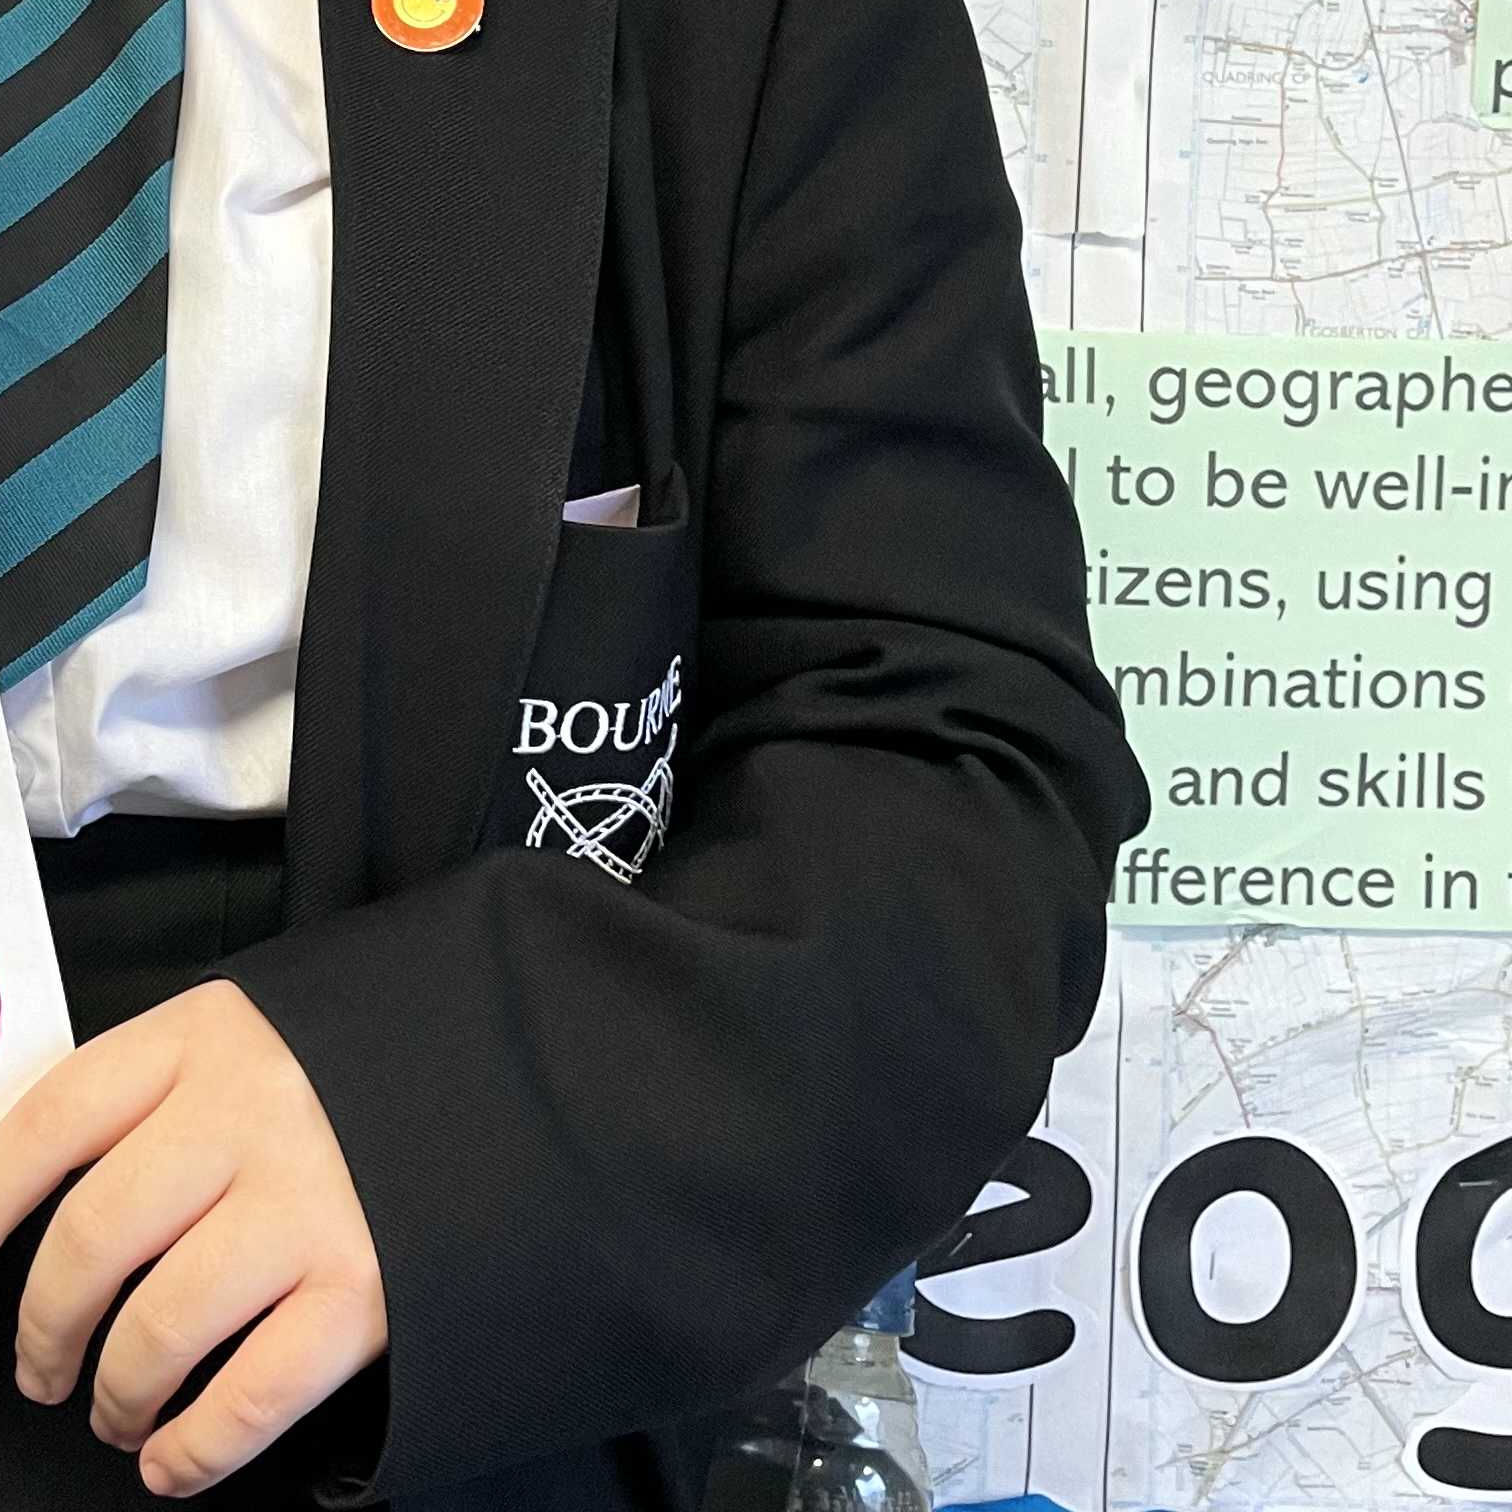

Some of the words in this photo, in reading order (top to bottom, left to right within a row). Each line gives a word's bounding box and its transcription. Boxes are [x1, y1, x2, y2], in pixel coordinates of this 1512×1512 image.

[1147, 356, 1512, 429] geographe
[1106, 455, 1175, 506] to
[1206, 450, 1288, 509] be
[1317, 554, 1492, 629] using
[512, 654, 682, 754] BOURNE
[1113, 650, 1486, 710] mbinations
[1168, 750, 1289, 807] and
[1317, 752, 1486, 811] skills
[1423, 852, 1479, 911] in
